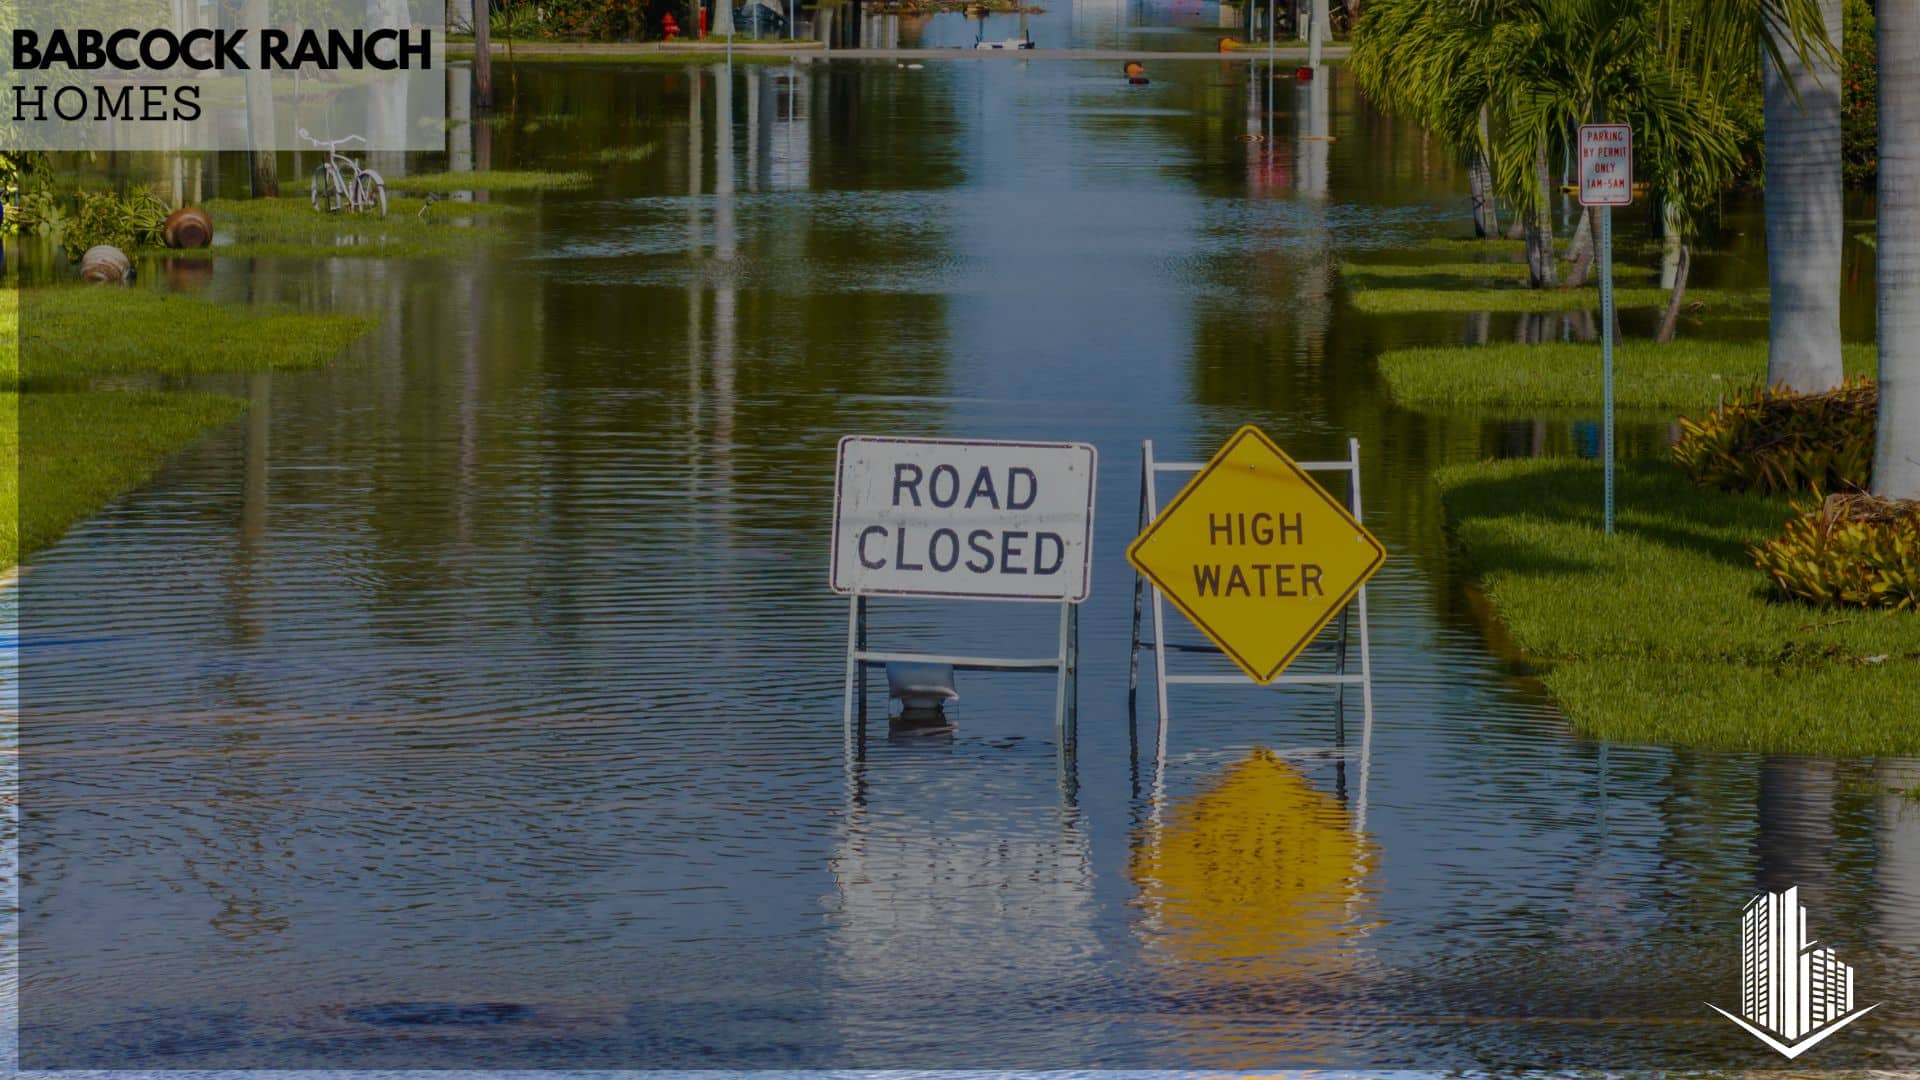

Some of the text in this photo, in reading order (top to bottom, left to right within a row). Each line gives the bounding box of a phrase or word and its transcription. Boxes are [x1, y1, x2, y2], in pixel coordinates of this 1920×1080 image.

[1583, 147, 1627, 158] BY PERMIT
[1587, 130, 1623, 142] PARKING
[1594, 162, 1616, 173] ONLY
[892, 462, 1039, 511] ROAD
[1209, 511, 1304, 546] HIGH
[857, 525, 1065, 576] CLOSED
[1193, 563, 1325, 598] WATER
